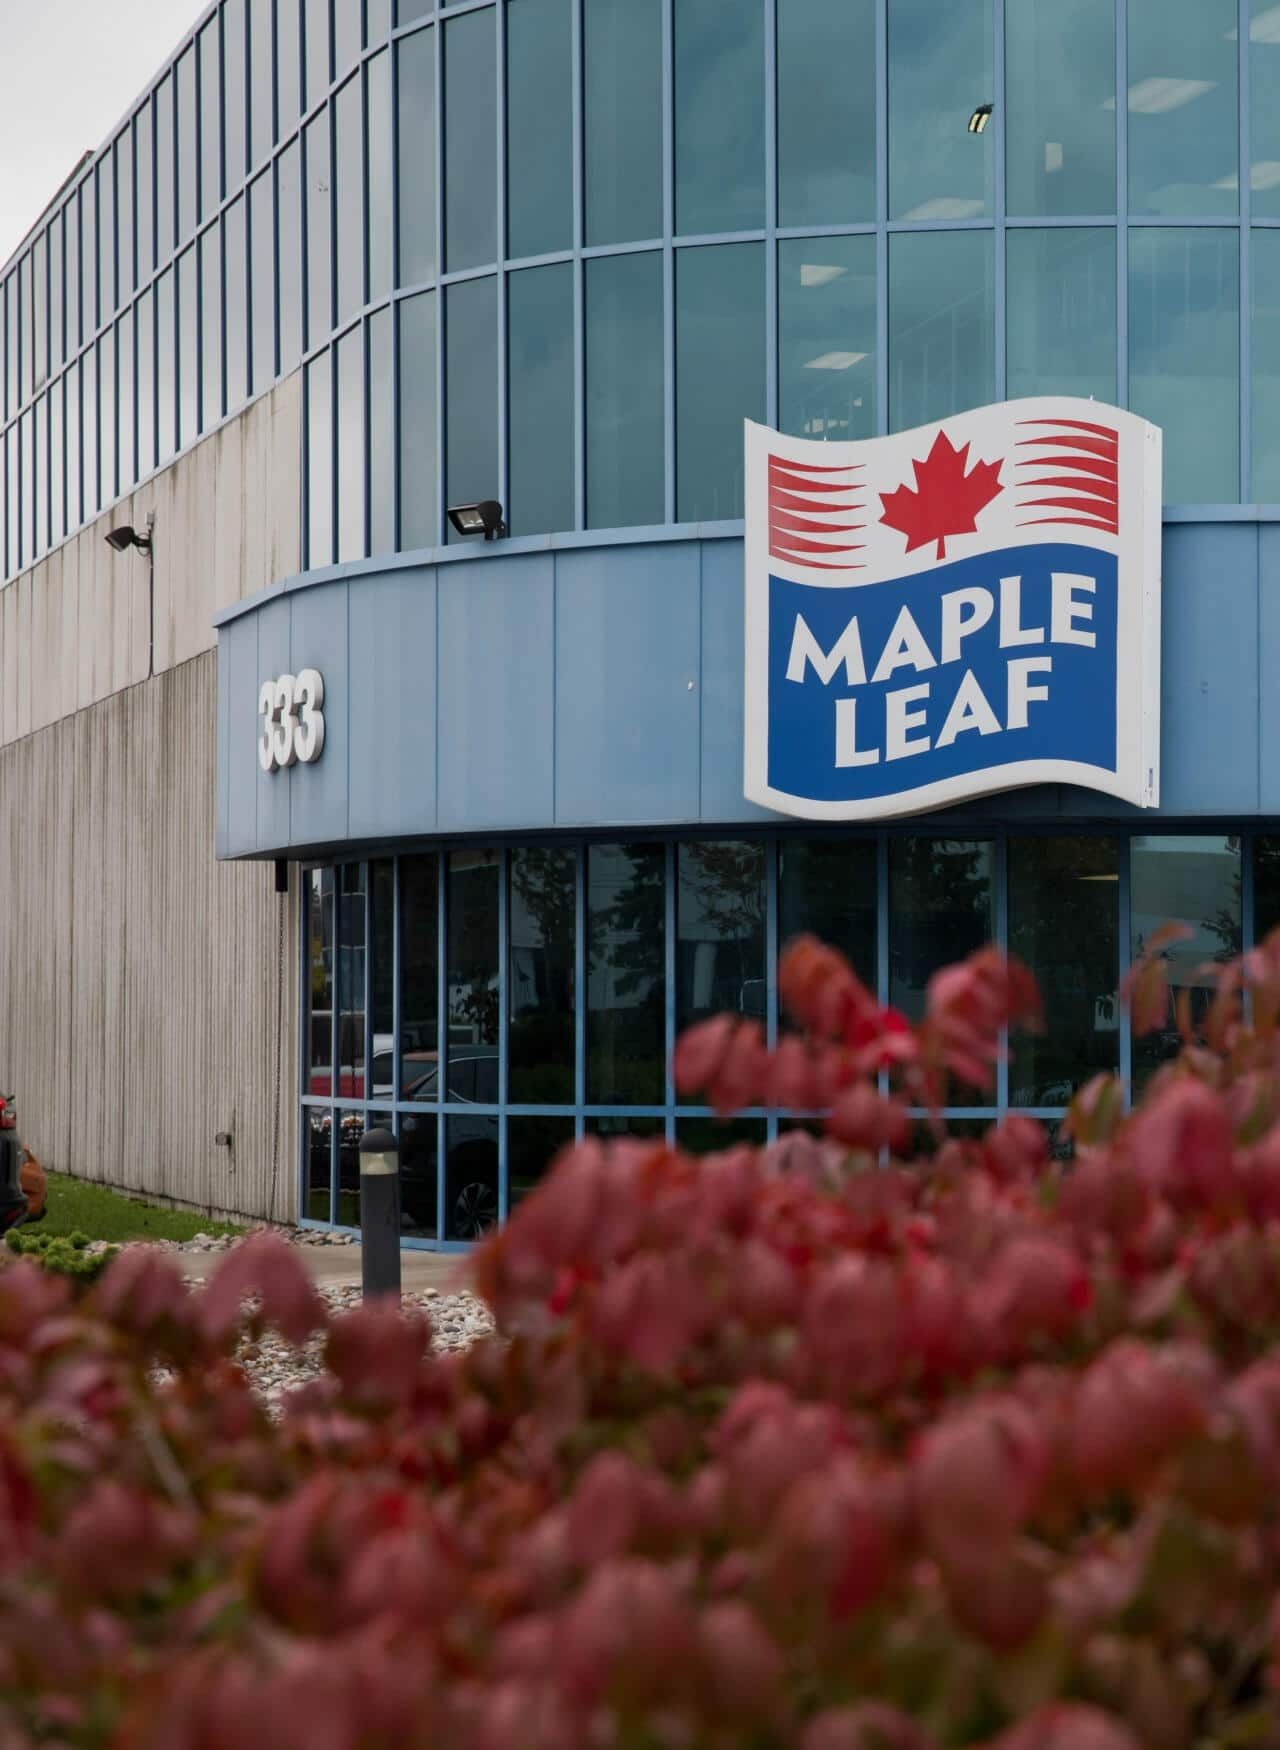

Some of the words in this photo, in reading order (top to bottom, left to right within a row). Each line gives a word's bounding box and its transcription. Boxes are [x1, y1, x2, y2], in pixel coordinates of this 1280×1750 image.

[785, 572, 1097, 687] MAPLE
[258, 668, 325, 771] 333
[834, 656, 1053, 769] LEAF
